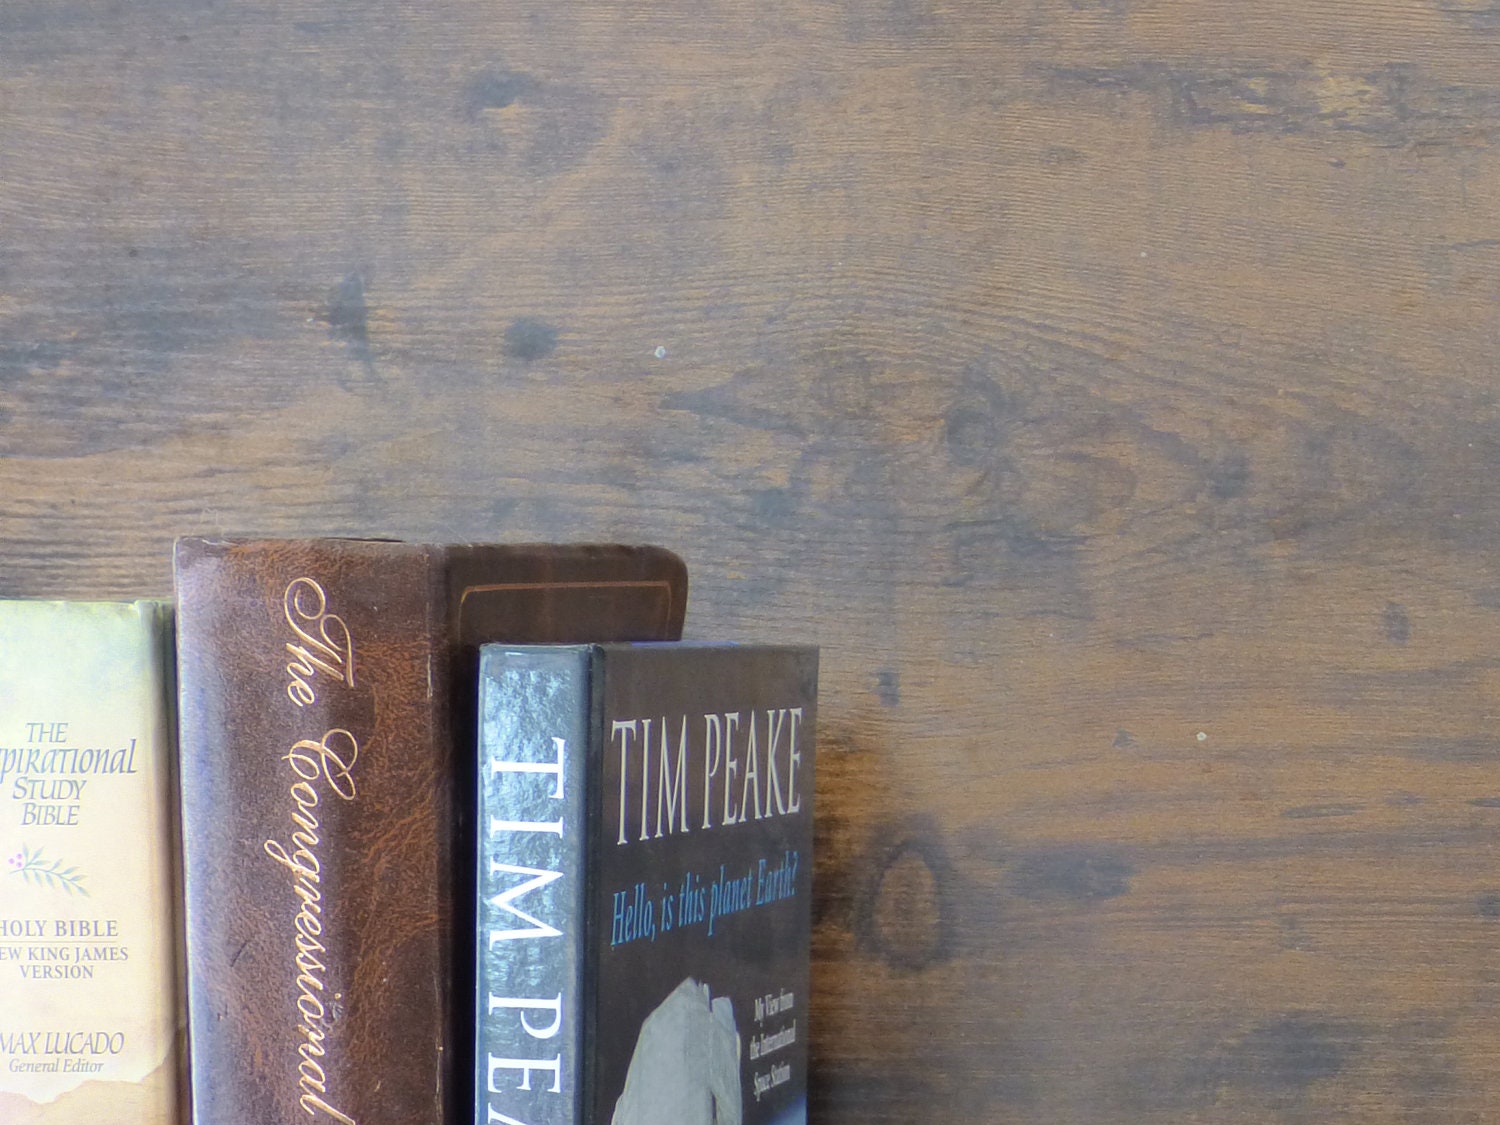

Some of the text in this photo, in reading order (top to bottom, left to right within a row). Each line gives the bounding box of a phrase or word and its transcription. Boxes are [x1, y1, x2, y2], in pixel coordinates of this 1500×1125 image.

[283, 576, 355, 708] The
[26, 722, 69, 743] THE
[610, 706, 803, 846] TIM PEAKE
[21, 802, 80, 826] BIBLE
[487, 736, 567, 951] TIM
[610, 850, 799, 946] Hello, is this planet Earth?
[54, 919, 119, 937] BIBLE
[28, 946, 70, 962] KING
[74, 946, 129, 964] JAMES
[19, 964, 95, 980] VERSION
[0, 1031, 125, 1055] MAX LUCADO
[9, 1058, 104, 1073] General Editor
